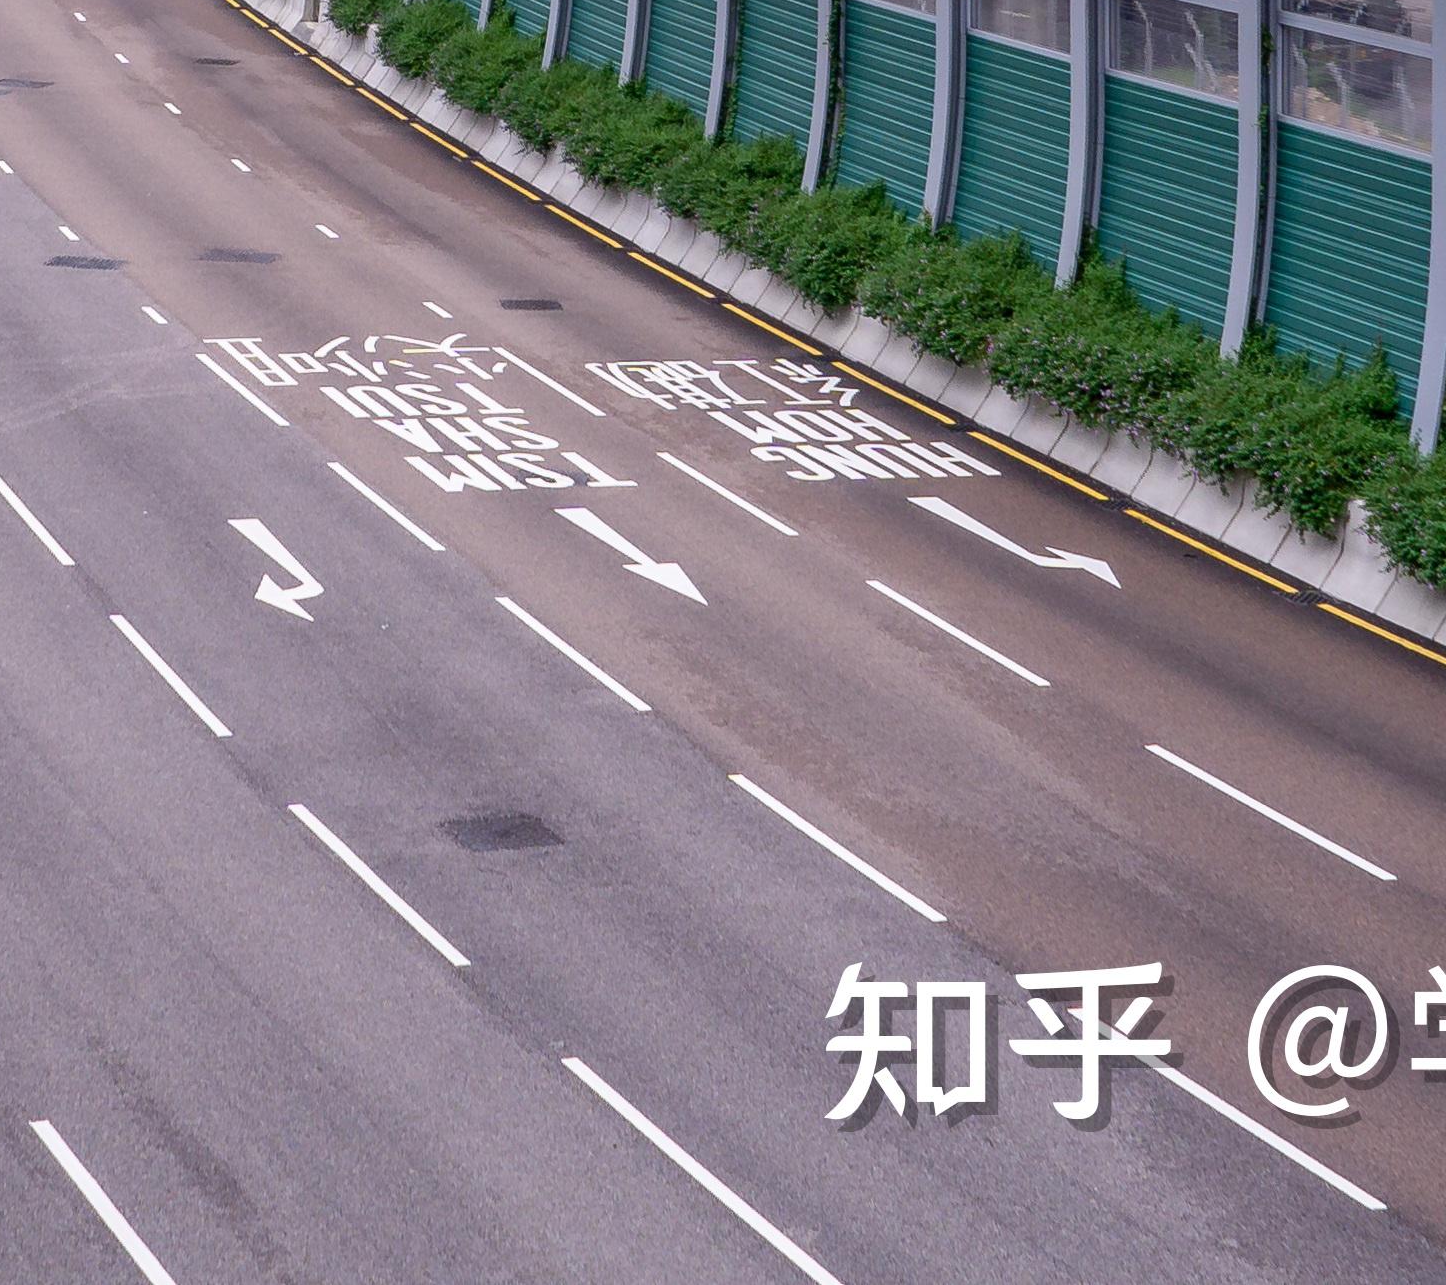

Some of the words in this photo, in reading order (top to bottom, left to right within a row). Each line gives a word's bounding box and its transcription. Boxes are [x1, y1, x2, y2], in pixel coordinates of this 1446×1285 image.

[203, 333, 508, 386] 尖沙咀
[319, 382, 525, 418] TSUI
[372, 416, 560, 452] SHA
[707, 408, 912, 445] HOM
[403, 451, 638, 492] TSIM
[749, 441, 1002, 481] HUNG
